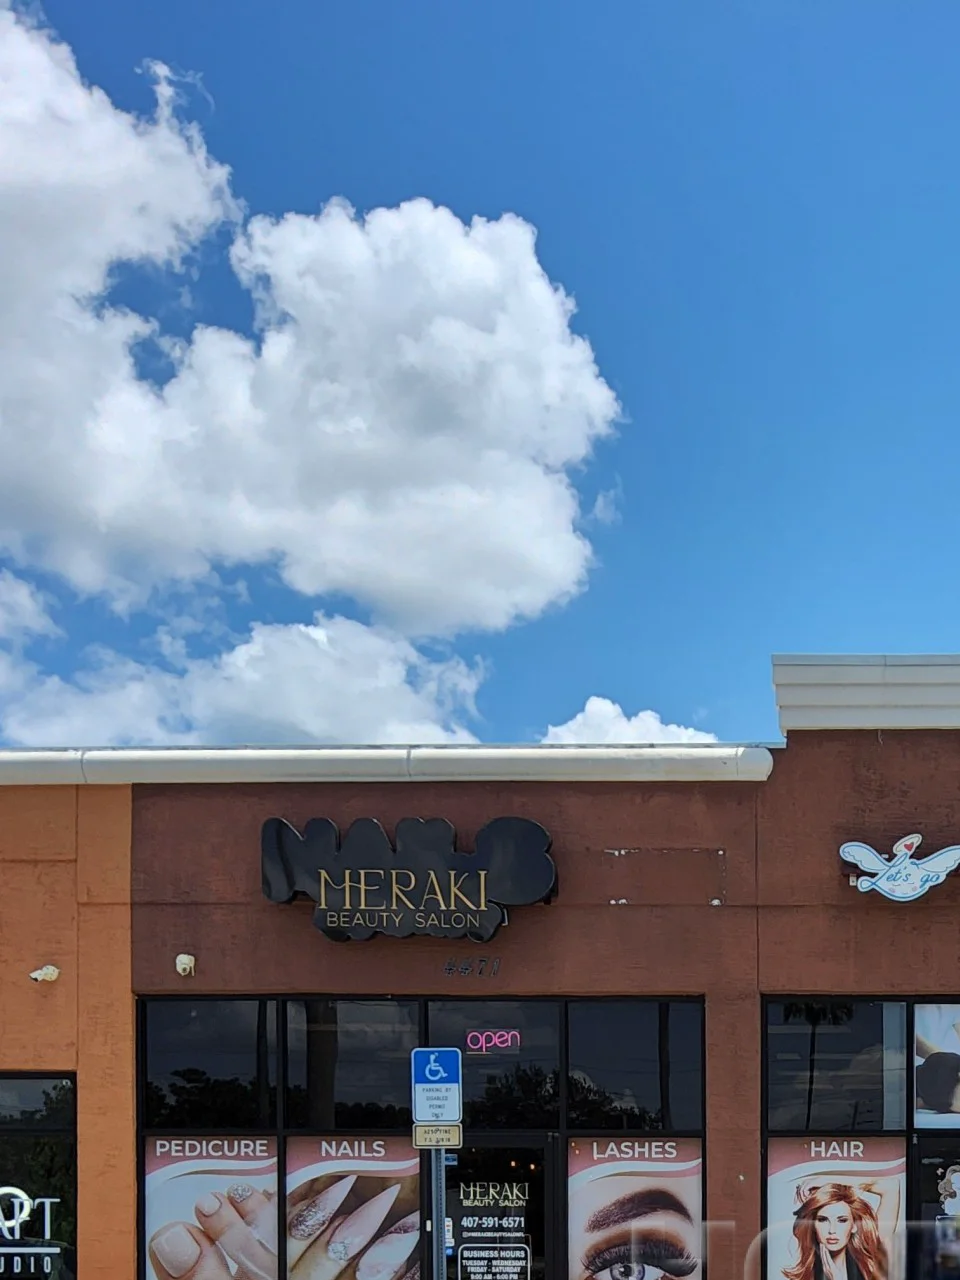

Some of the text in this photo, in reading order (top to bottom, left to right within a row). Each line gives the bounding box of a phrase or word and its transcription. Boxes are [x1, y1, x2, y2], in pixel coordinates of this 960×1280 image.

[317, 869, 488, 911] MERAKI
[326, 912, 480, 928] BEAUTY SALON
[443, 957, 501, 978] 4471
[466, 1031, 521, 1054] open
[156, 1140, 269, 1157] PEDICURE
[321, 1140, 386, 1158] NAILS
[593, 1141, 677, 1159] LASHES
[810, 1140, 864, 1158] HAIR
[459, 1182, 530, 1199] MERAKI
[460, 1216, 525, 1228] 407-591-6571
[462, 1250, 526, 1258] BUSINESS HOURS
